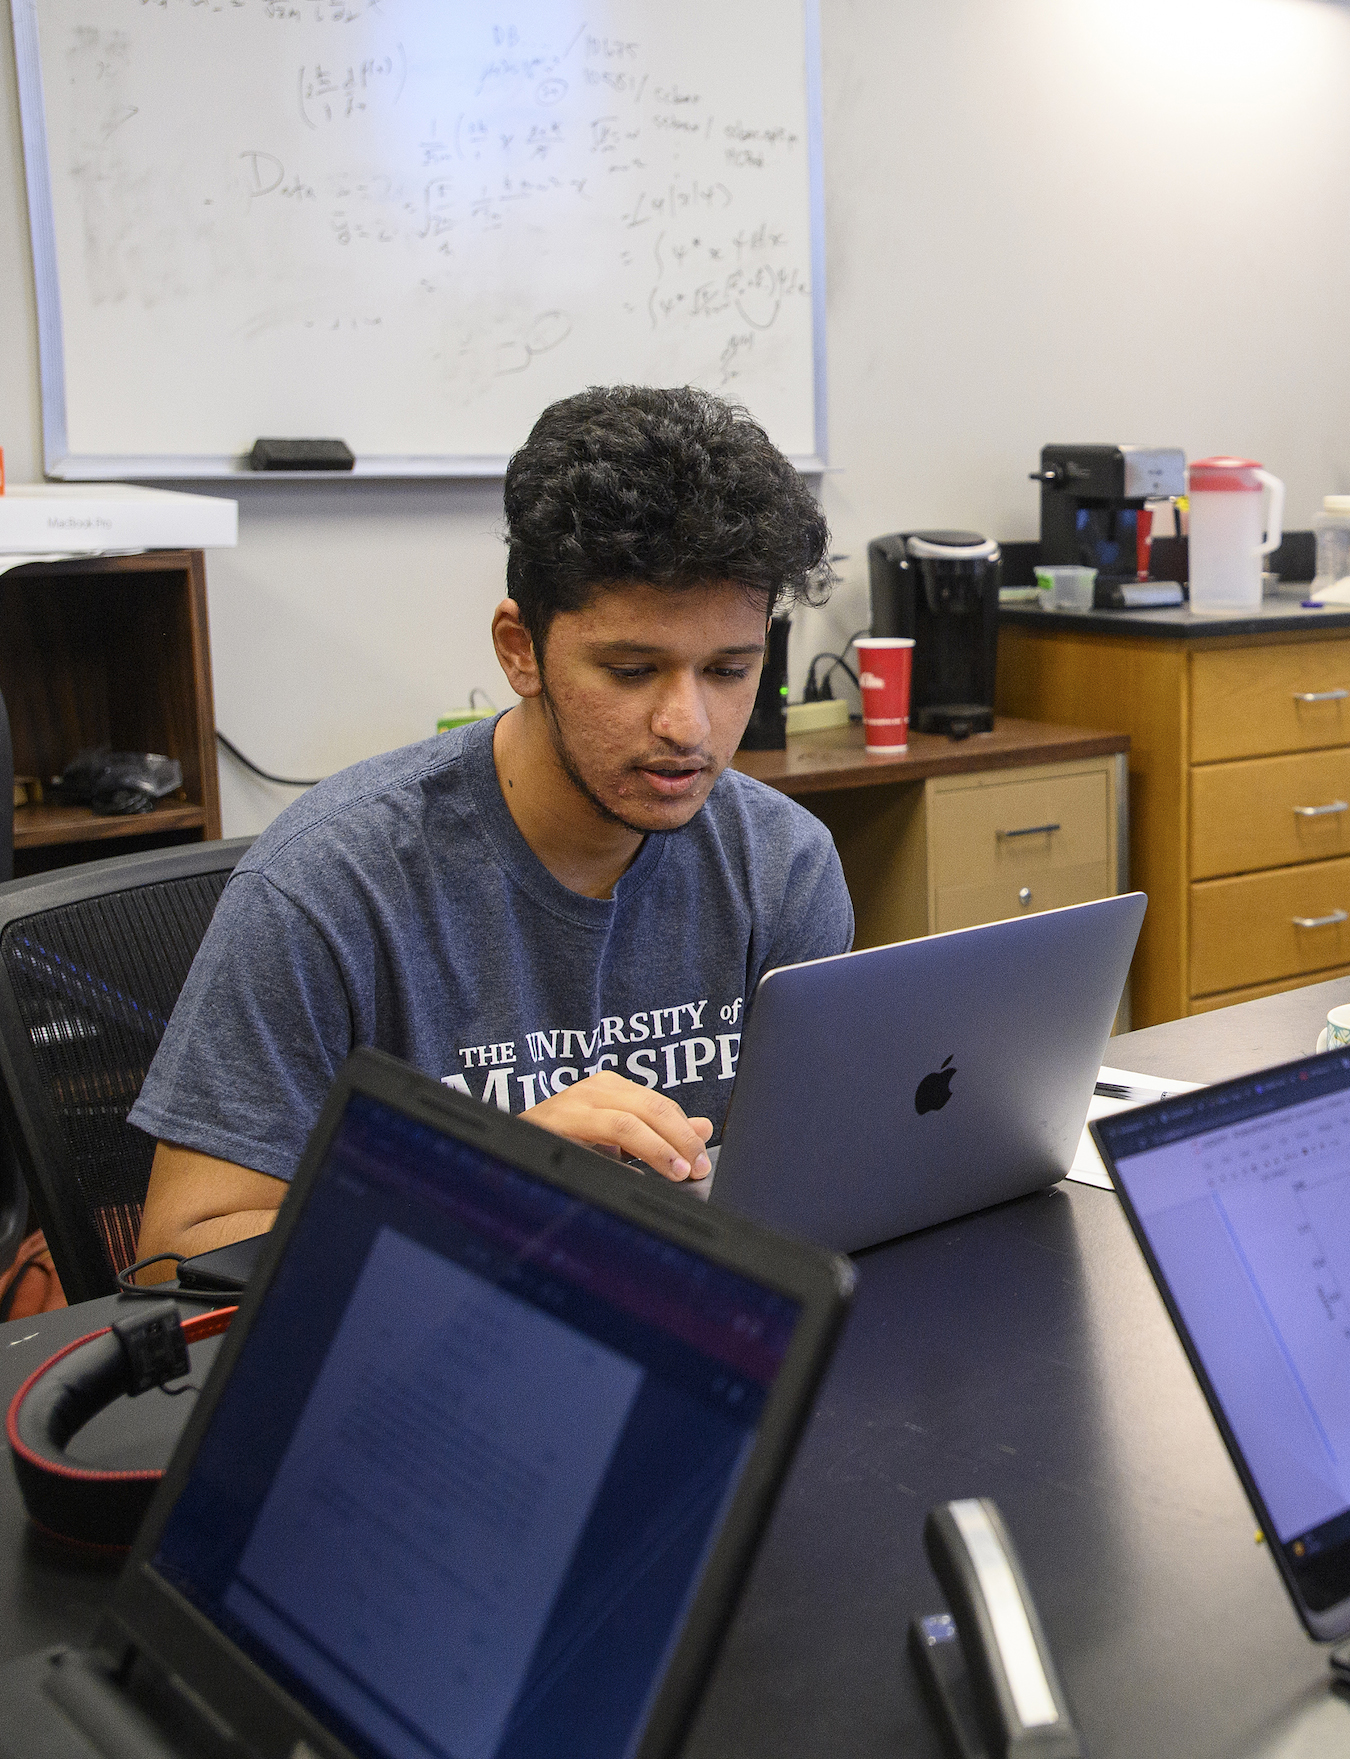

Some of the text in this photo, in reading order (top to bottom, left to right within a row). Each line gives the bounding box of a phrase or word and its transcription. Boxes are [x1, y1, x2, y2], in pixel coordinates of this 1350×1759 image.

[239, 150, 317, 202] Data
[47, 516, 112, 530] MacBook Pro
[459, 1042, 517, 1068] THE
[719, 997, 743, 1025] of
